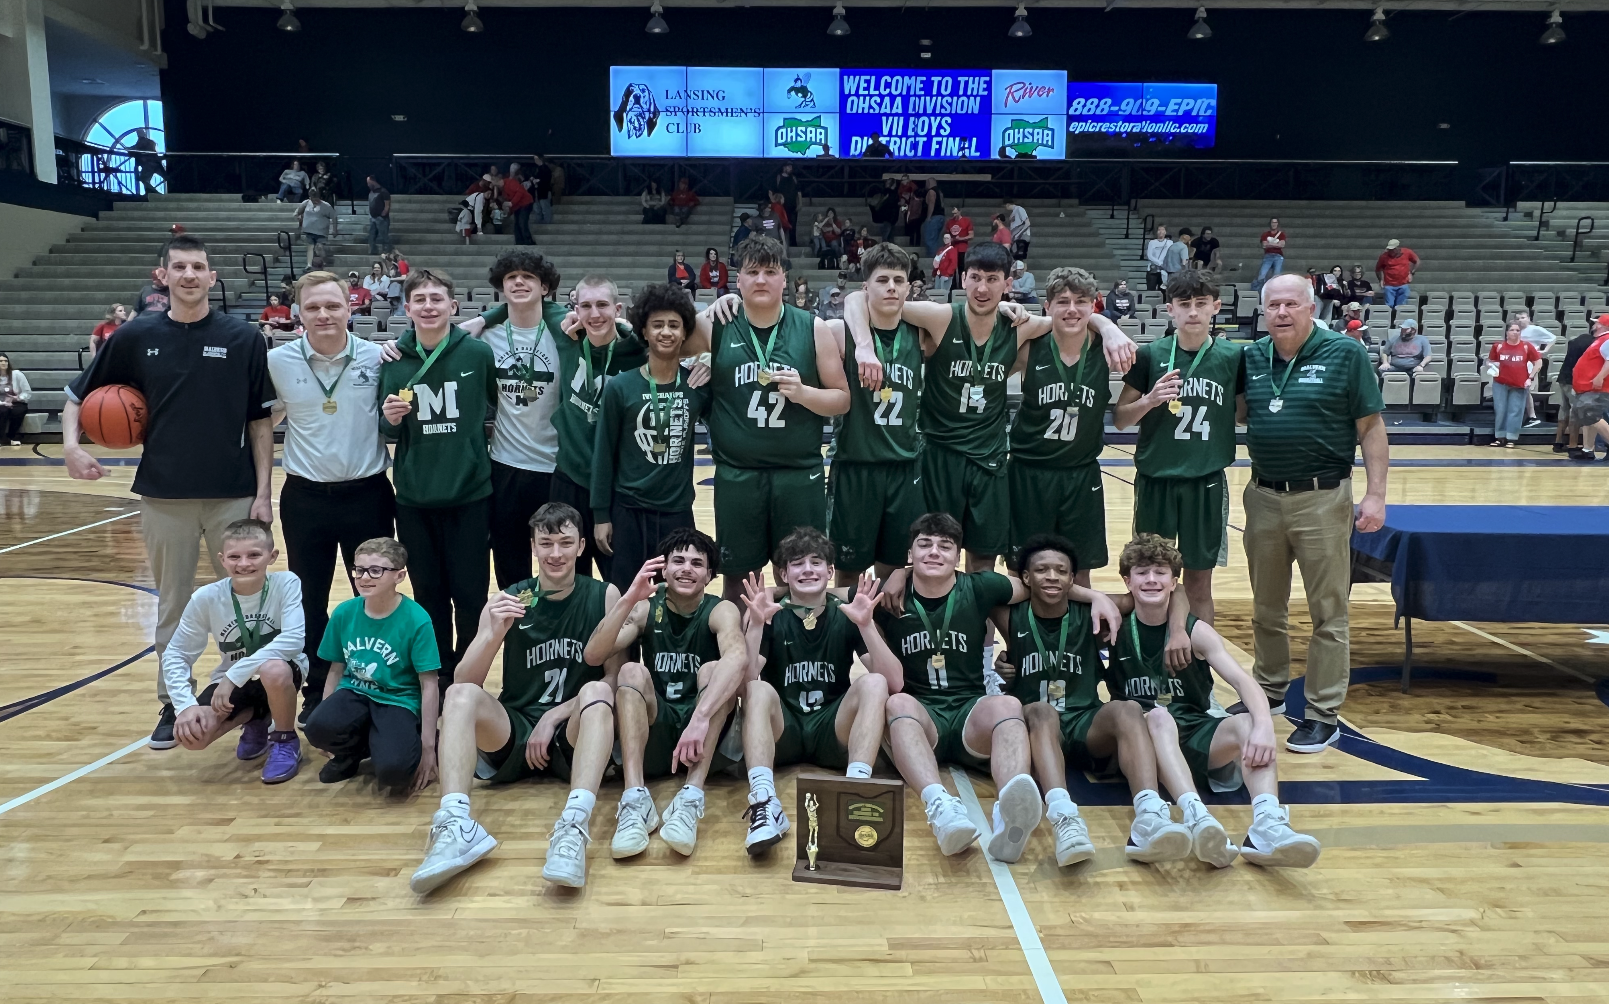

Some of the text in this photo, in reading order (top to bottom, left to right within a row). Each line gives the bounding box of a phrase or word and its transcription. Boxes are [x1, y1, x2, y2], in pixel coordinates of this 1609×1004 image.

[665, 89, 726, 101] LANSING
[843, 75, 990, 95] WELCOME TO THE
[1004, 81, 1055, 108] River
[665, 105, 761, 118] SPORTSMEN'S
[846, 96, 981, 114] OHSAA DIVISION
[1068, 97, 1216, 116] 888-909-EPIC
[665, 122, 702, 134] CLUB
[777, 126, 825, 144] OHSAA
[882, 116, 952, 136] VII BOYS
[1004, 128, 1053, 145] OHSAA
[850, 136, 927, 157] DITRICT
[949, 360, 1005, 382] HORETS
[413, 381, 460, 420] M
[747, 390, 786, 428] 42
[873, 391, 904, 426] 22
[422, 422, 457, 435] HORNETS
[1043, 408, 1079, 442] 20
[1174, 405, 1211, 441] 24
[526, 638, 583, 669] HORNETS
[784, 661, 836, 687] HORNETS
[538, 667, 568, 704] 21
